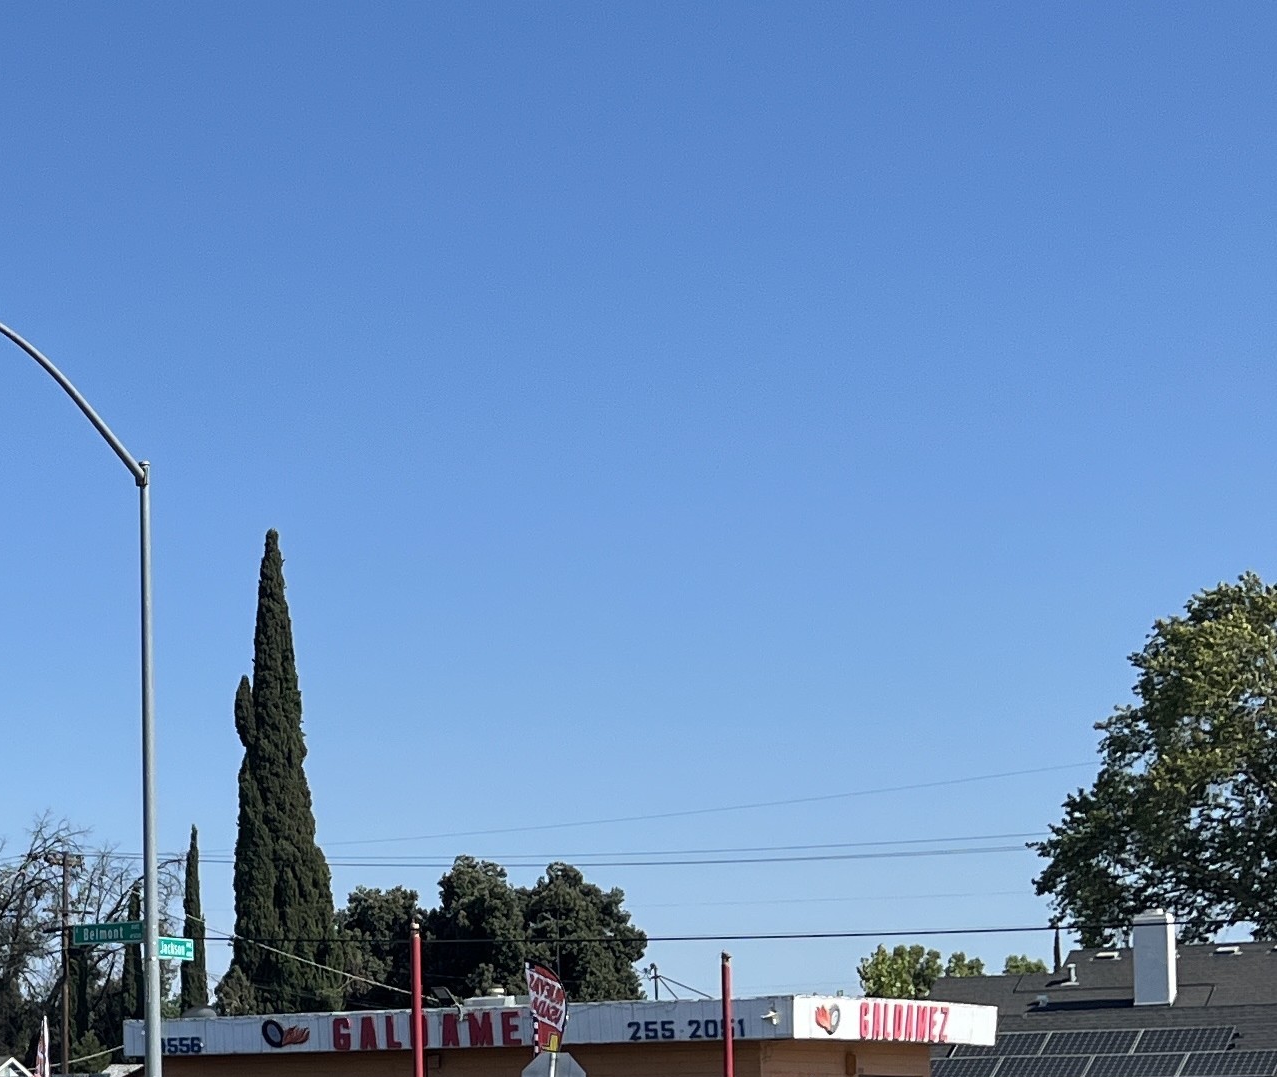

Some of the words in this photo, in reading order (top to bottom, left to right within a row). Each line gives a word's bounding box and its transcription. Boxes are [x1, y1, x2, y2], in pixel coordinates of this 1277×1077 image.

[83, 925, 124, 941] Belmont
[159, 940, 186, 956] Jackson
[332, 1011, 523, 1050] GALAME
[627, 1020, 675, 1041] 255
[859, 1001, 950, 1043] GALDAMEZ
